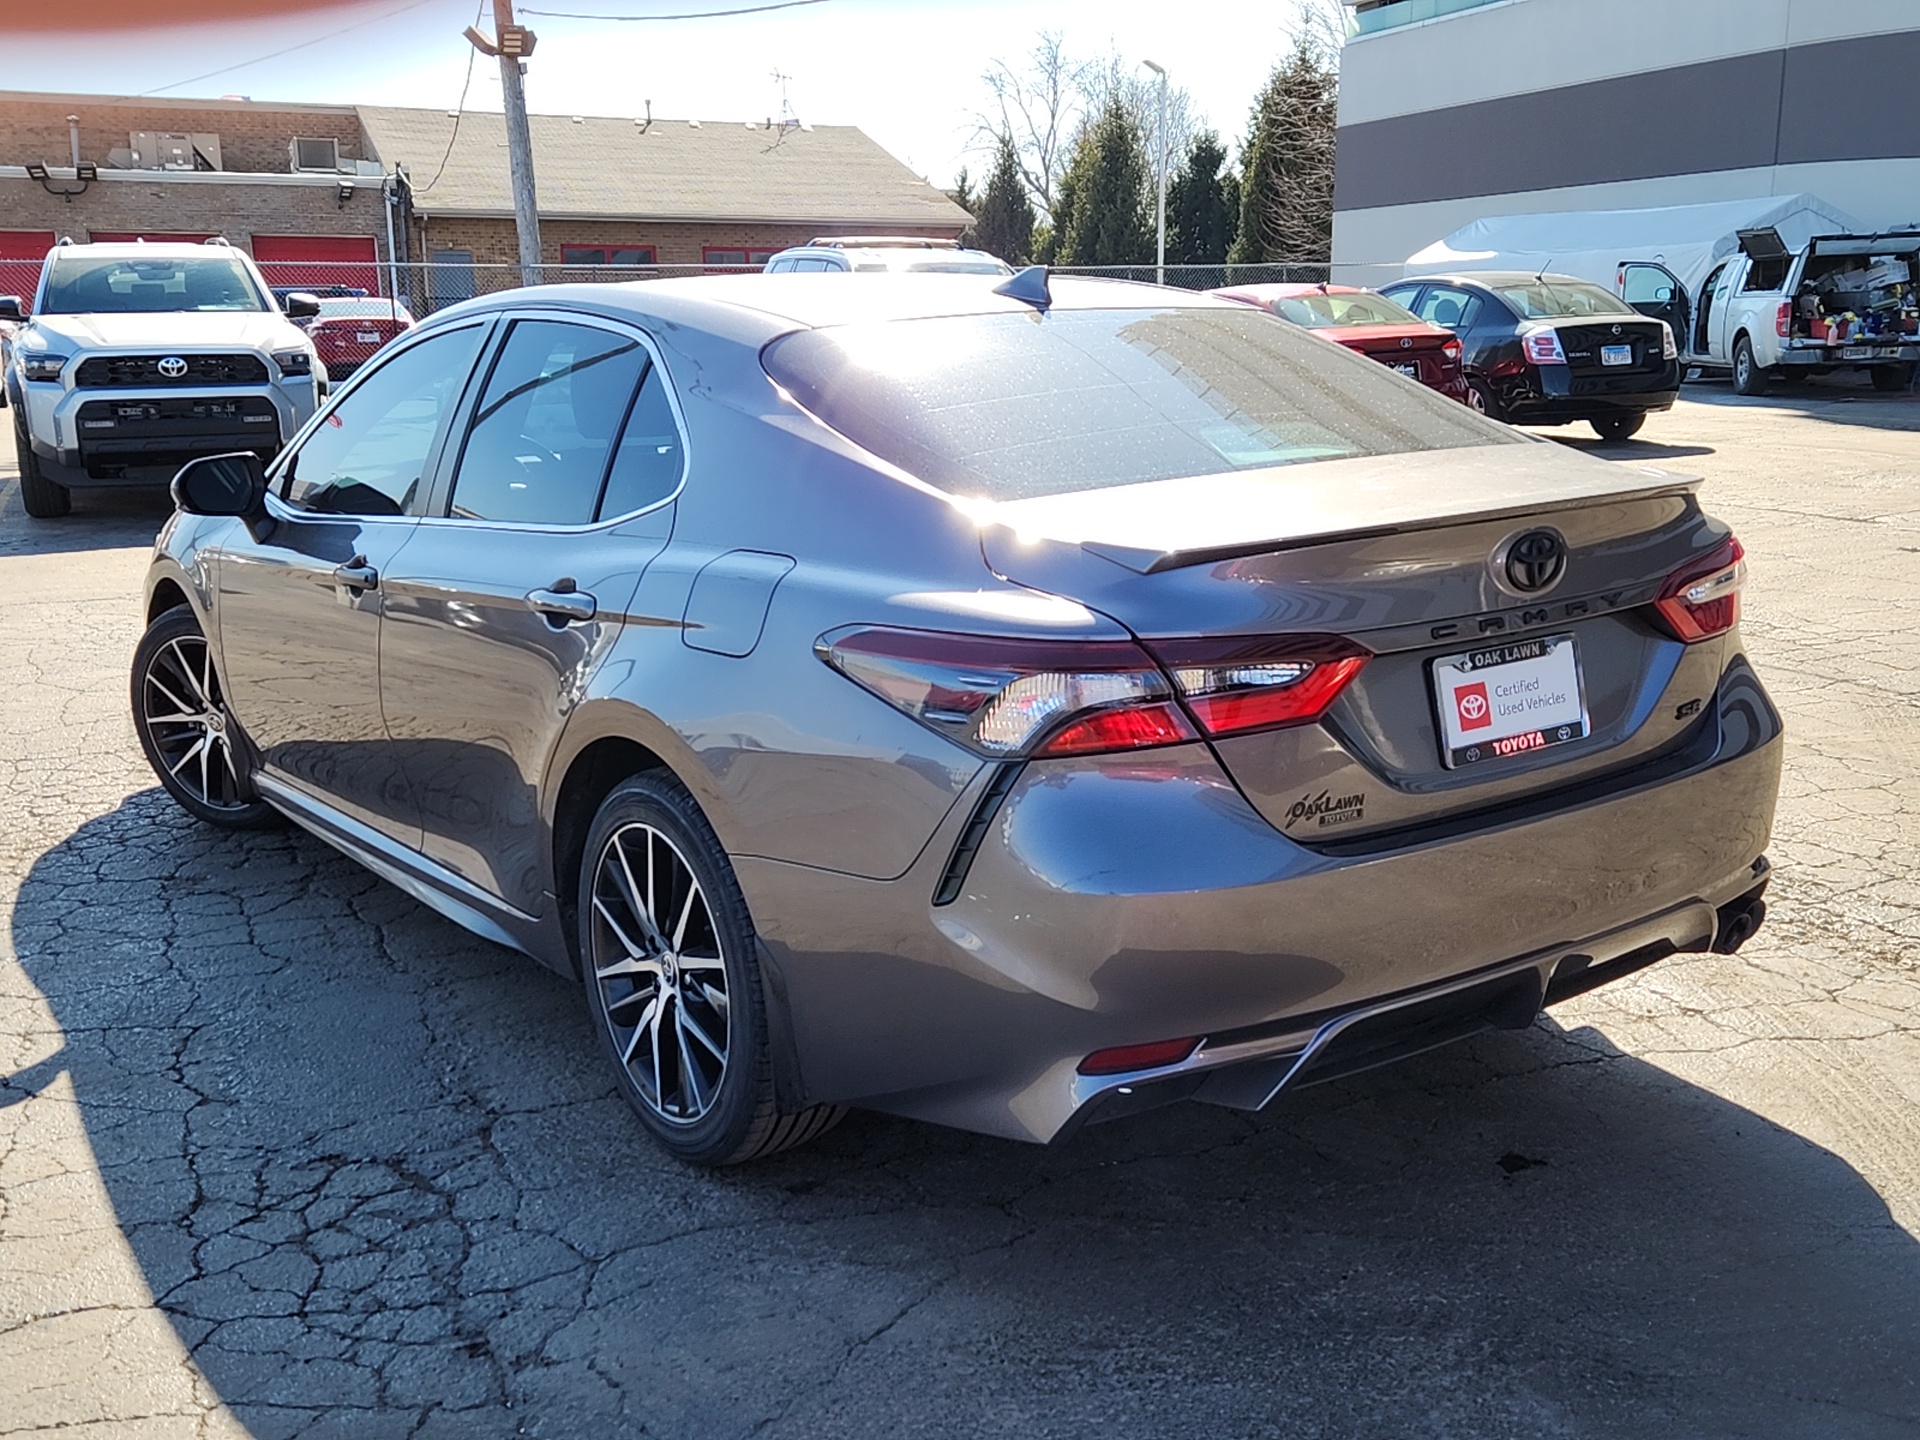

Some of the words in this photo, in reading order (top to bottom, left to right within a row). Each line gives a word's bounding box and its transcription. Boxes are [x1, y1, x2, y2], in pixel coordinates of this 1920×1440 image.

[1430, 592, 1623, 640] CAMRY
[1475, 650, 1502, 667] OAK
[1505, 643, 1540, 662] LAWN
[1495, 677, 1539, 697] Certified
[1498, 702, 1524, 716] Used
[1526, 692, 1566, 710] Vehicles
[1493, 732, 1545, 755] TOYOTA
